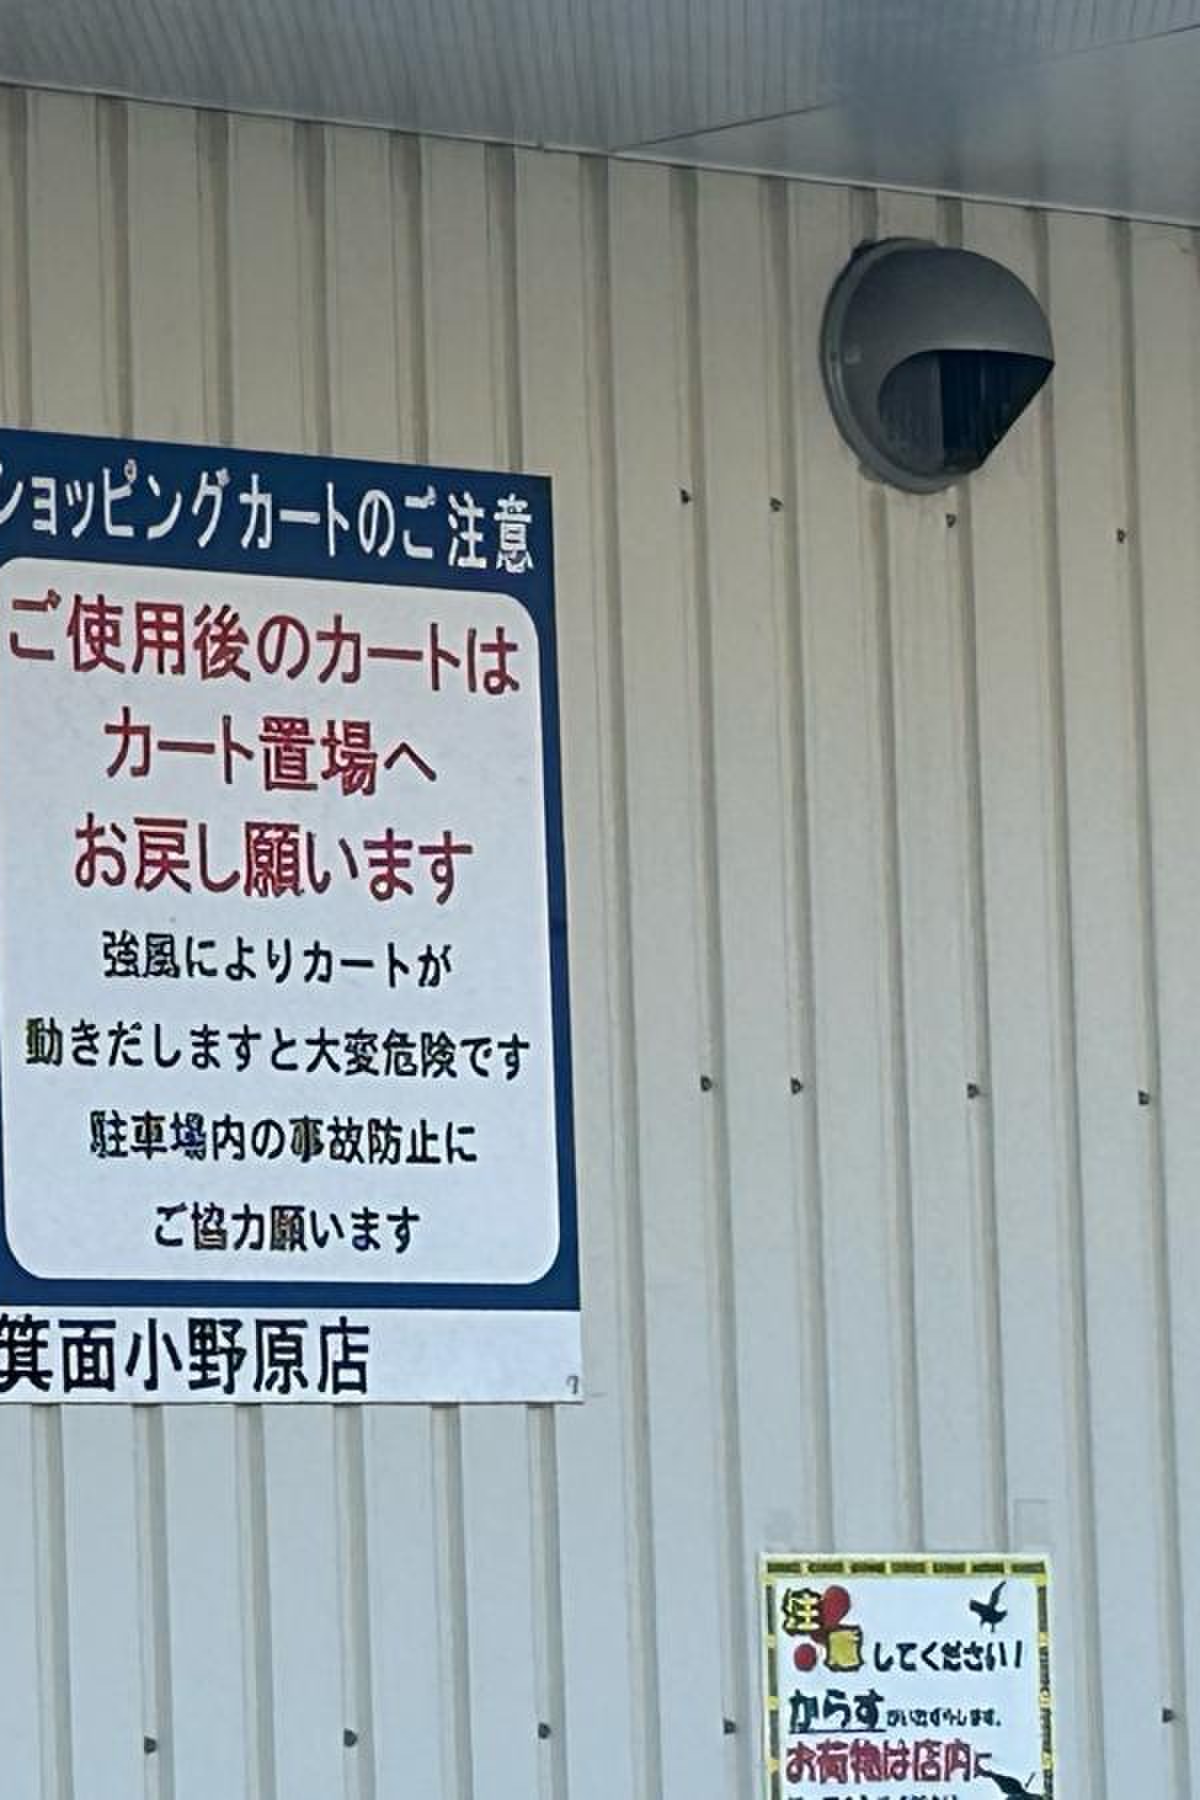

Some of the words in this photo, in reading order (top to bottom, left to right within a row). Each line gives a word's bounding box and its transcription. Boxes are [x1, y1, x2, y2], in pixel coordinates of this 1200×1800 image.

[7, 589, 521, 696] ご使用後のカートは
[103, 706, 438, 798] カート置場へ
[74, 811, 473, 906] お戻し願います
[101, 929, 453, 990] 強風によりカートが
[24, 1016, 531, 1082] 動きだしますと大変危険です
[89, 1109, 479, 1166] 駐車場内の事故防止に
[152, 1202, 422, 1254] ご協力願います
